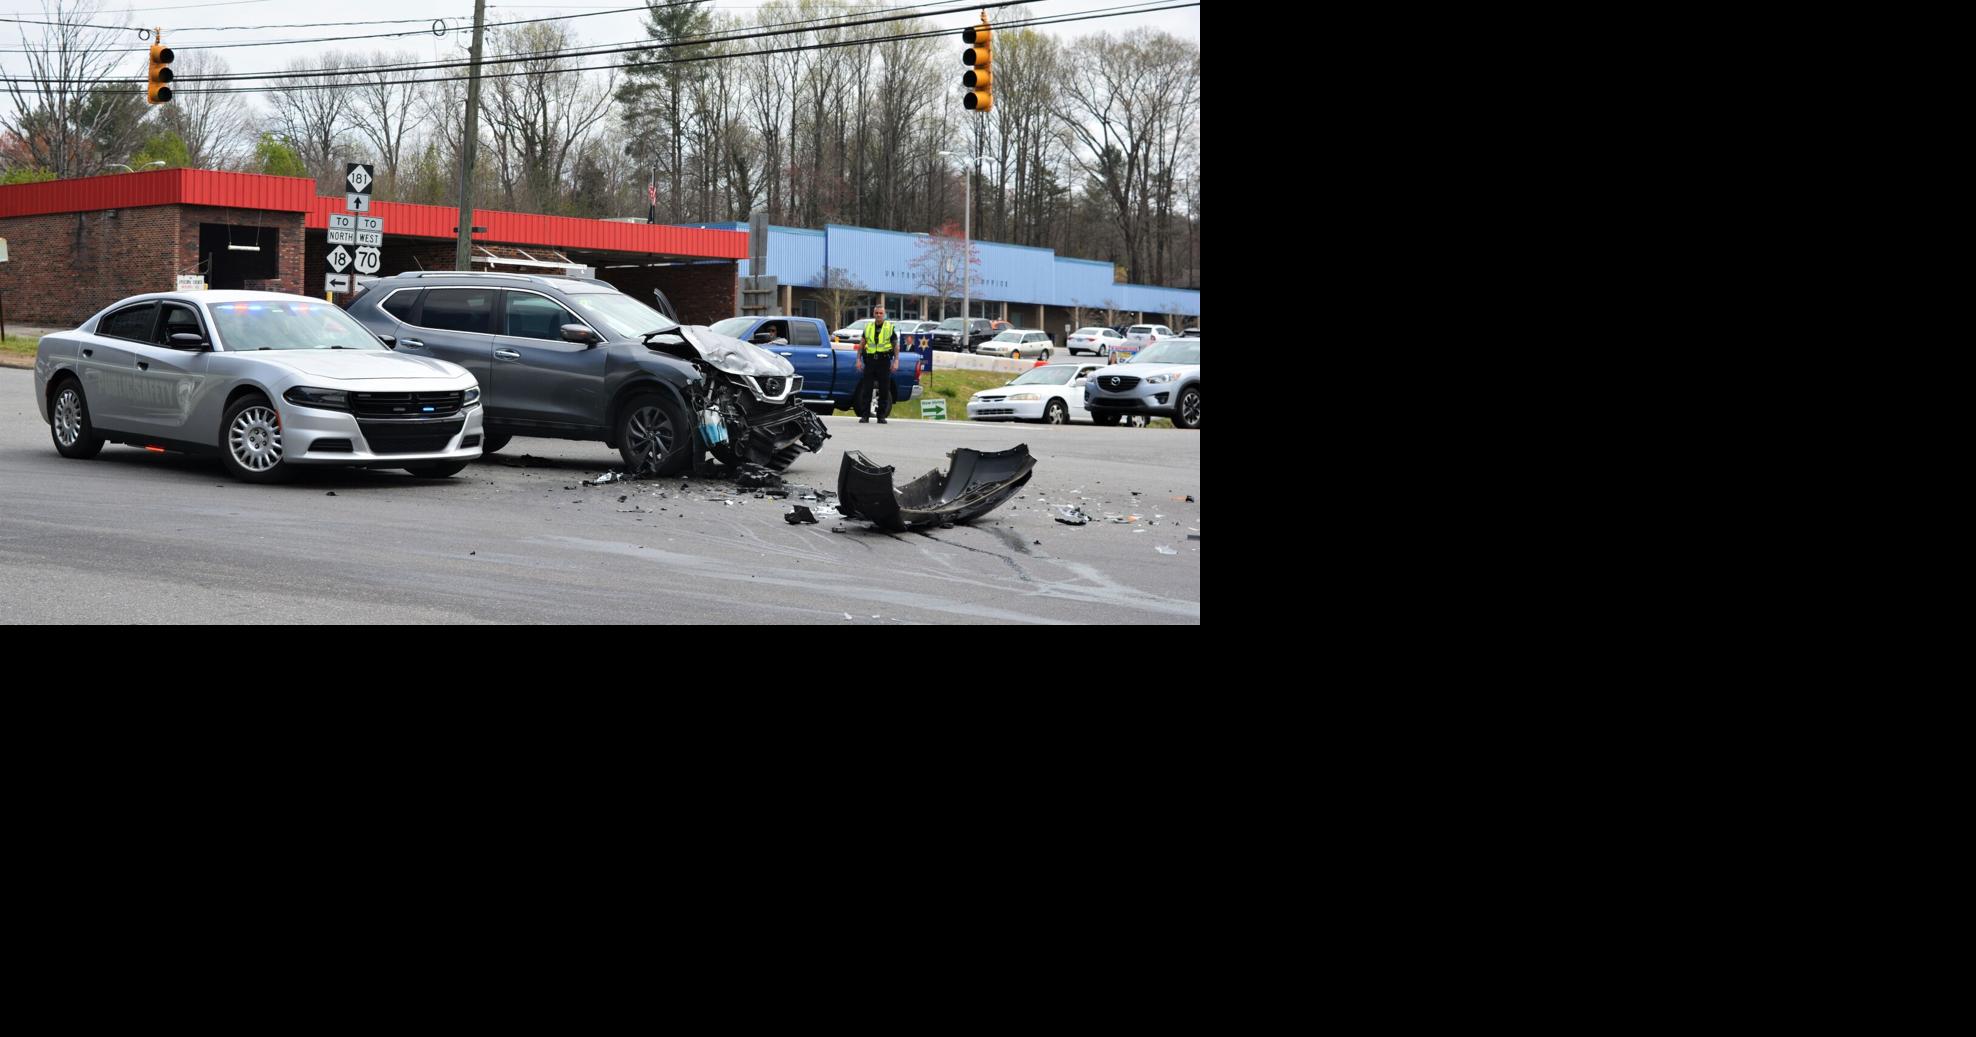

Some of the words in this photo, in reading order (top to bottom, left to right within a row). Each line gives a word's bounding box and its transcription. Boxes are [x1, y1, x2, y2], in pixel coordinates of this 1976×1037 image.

[351, 172, 367, 184] 181
[336, 217, 349, 226] TO
[364, 219, 377, 228] TO
[329, 232, 353, 241] NORTH
[360, 234, 378, 244] WEST
[334, 252, 346, 266] 18
[359, 252, 378, 268] 70
[135, 377, 174, 405] SAFETY
